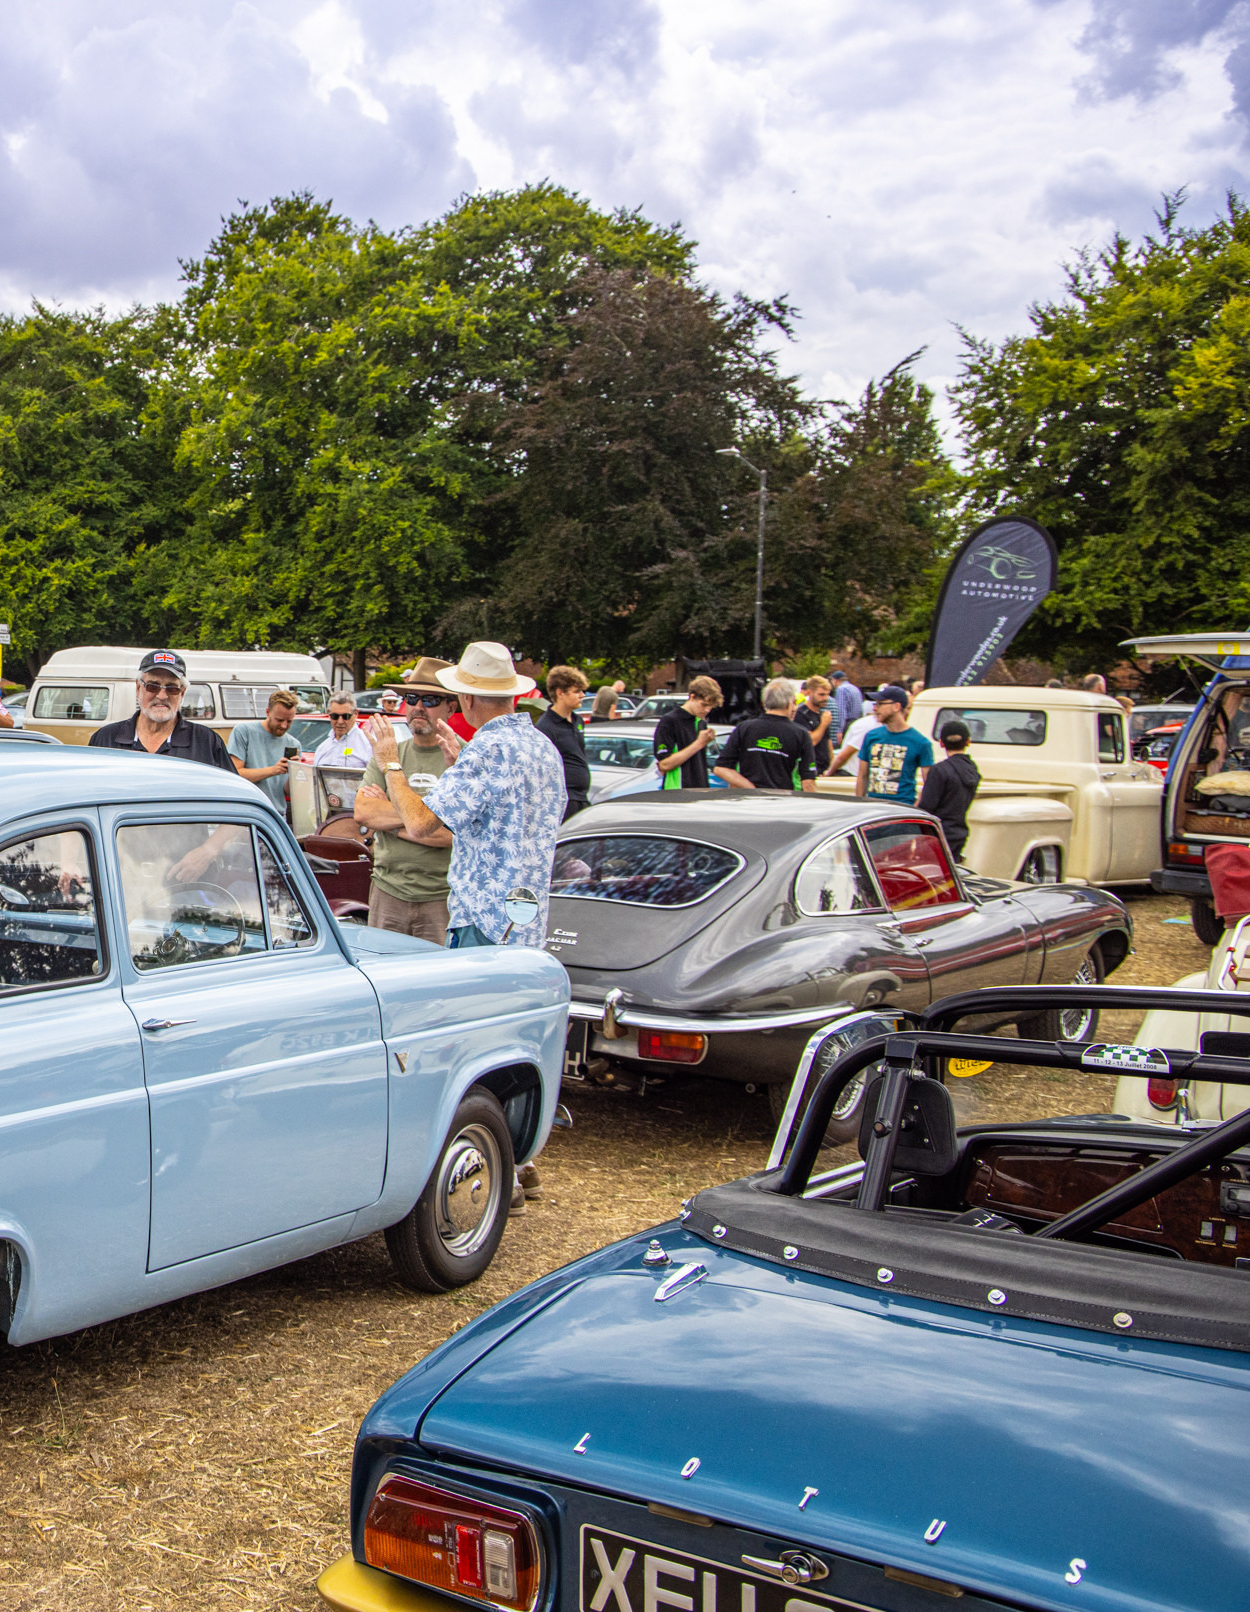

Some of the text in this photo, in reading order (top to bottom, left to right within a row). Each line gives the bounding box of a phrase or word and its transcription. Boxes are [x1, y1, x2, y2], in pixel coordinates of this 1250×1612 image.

[962, 581, 1037, 592] UNDERWOOD
[961, 589, 1034, 600] AUTOMOTIVE
[546, 937, 578, 946] JAGUAR
